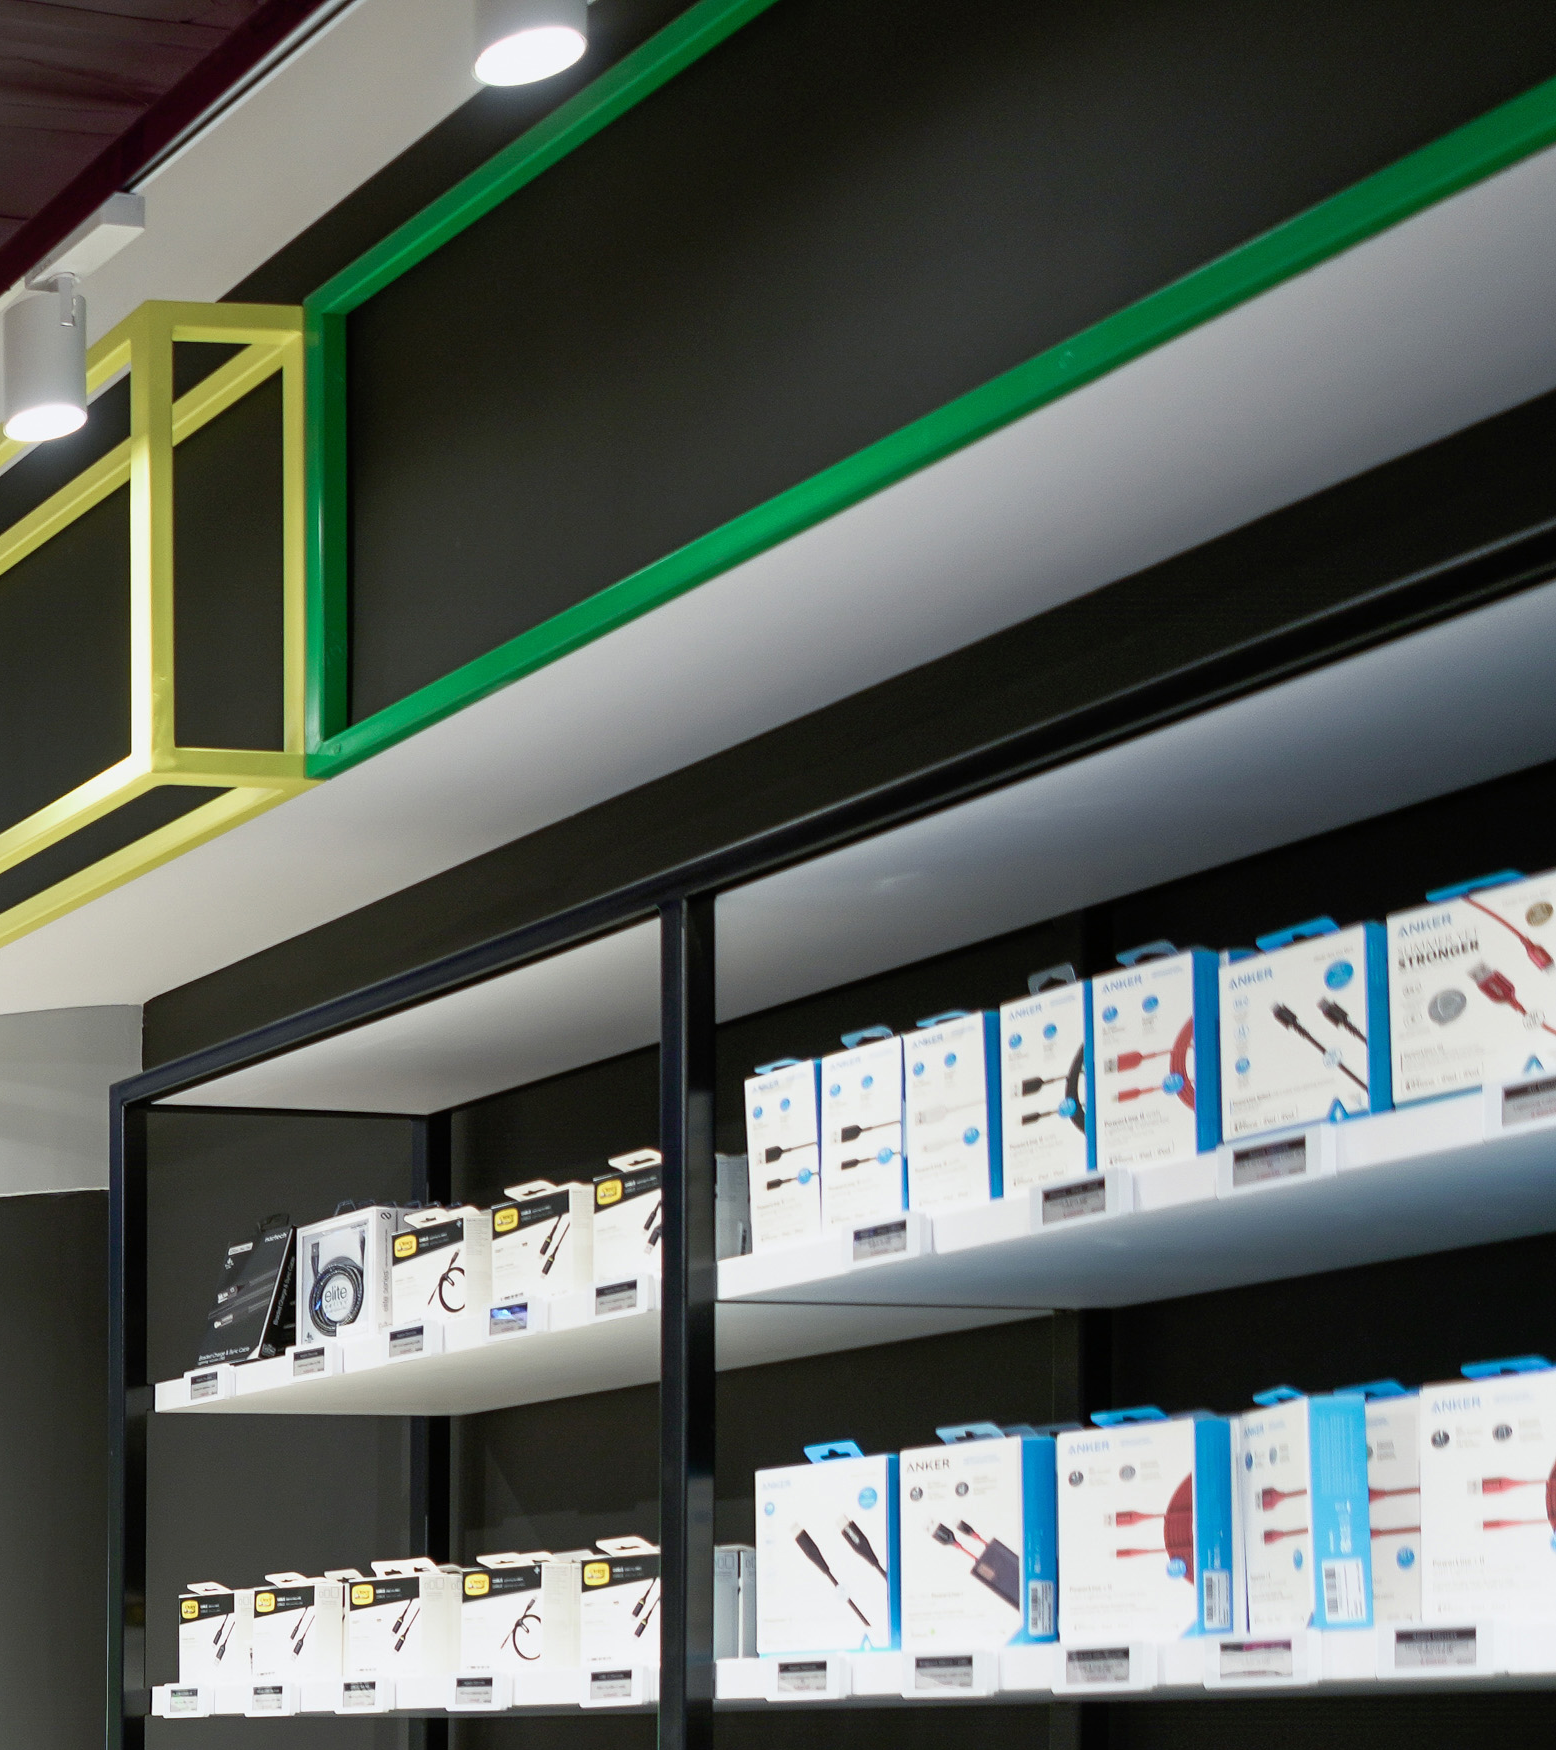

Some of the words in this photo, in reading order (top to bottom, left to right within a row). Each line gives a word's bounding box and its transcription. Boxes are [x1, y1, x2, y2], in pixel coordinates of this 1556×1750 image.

[1397, 912, 1453, 938] ANKER
[1397, 939, 1480, 969] STRONGER
[1101, 974, 1142, 995] ANKER
[1228, 967, 1274, 991] ANKER
[1008, 1003, 1043, 1022] ANKER
[911, 1031, 944, 1050] ANKER
[324, 1282, 348, 1303] elite
[1067, 1440, 1111, 1456] ANKER
[906, 1457, 951, 1473] ANKER
